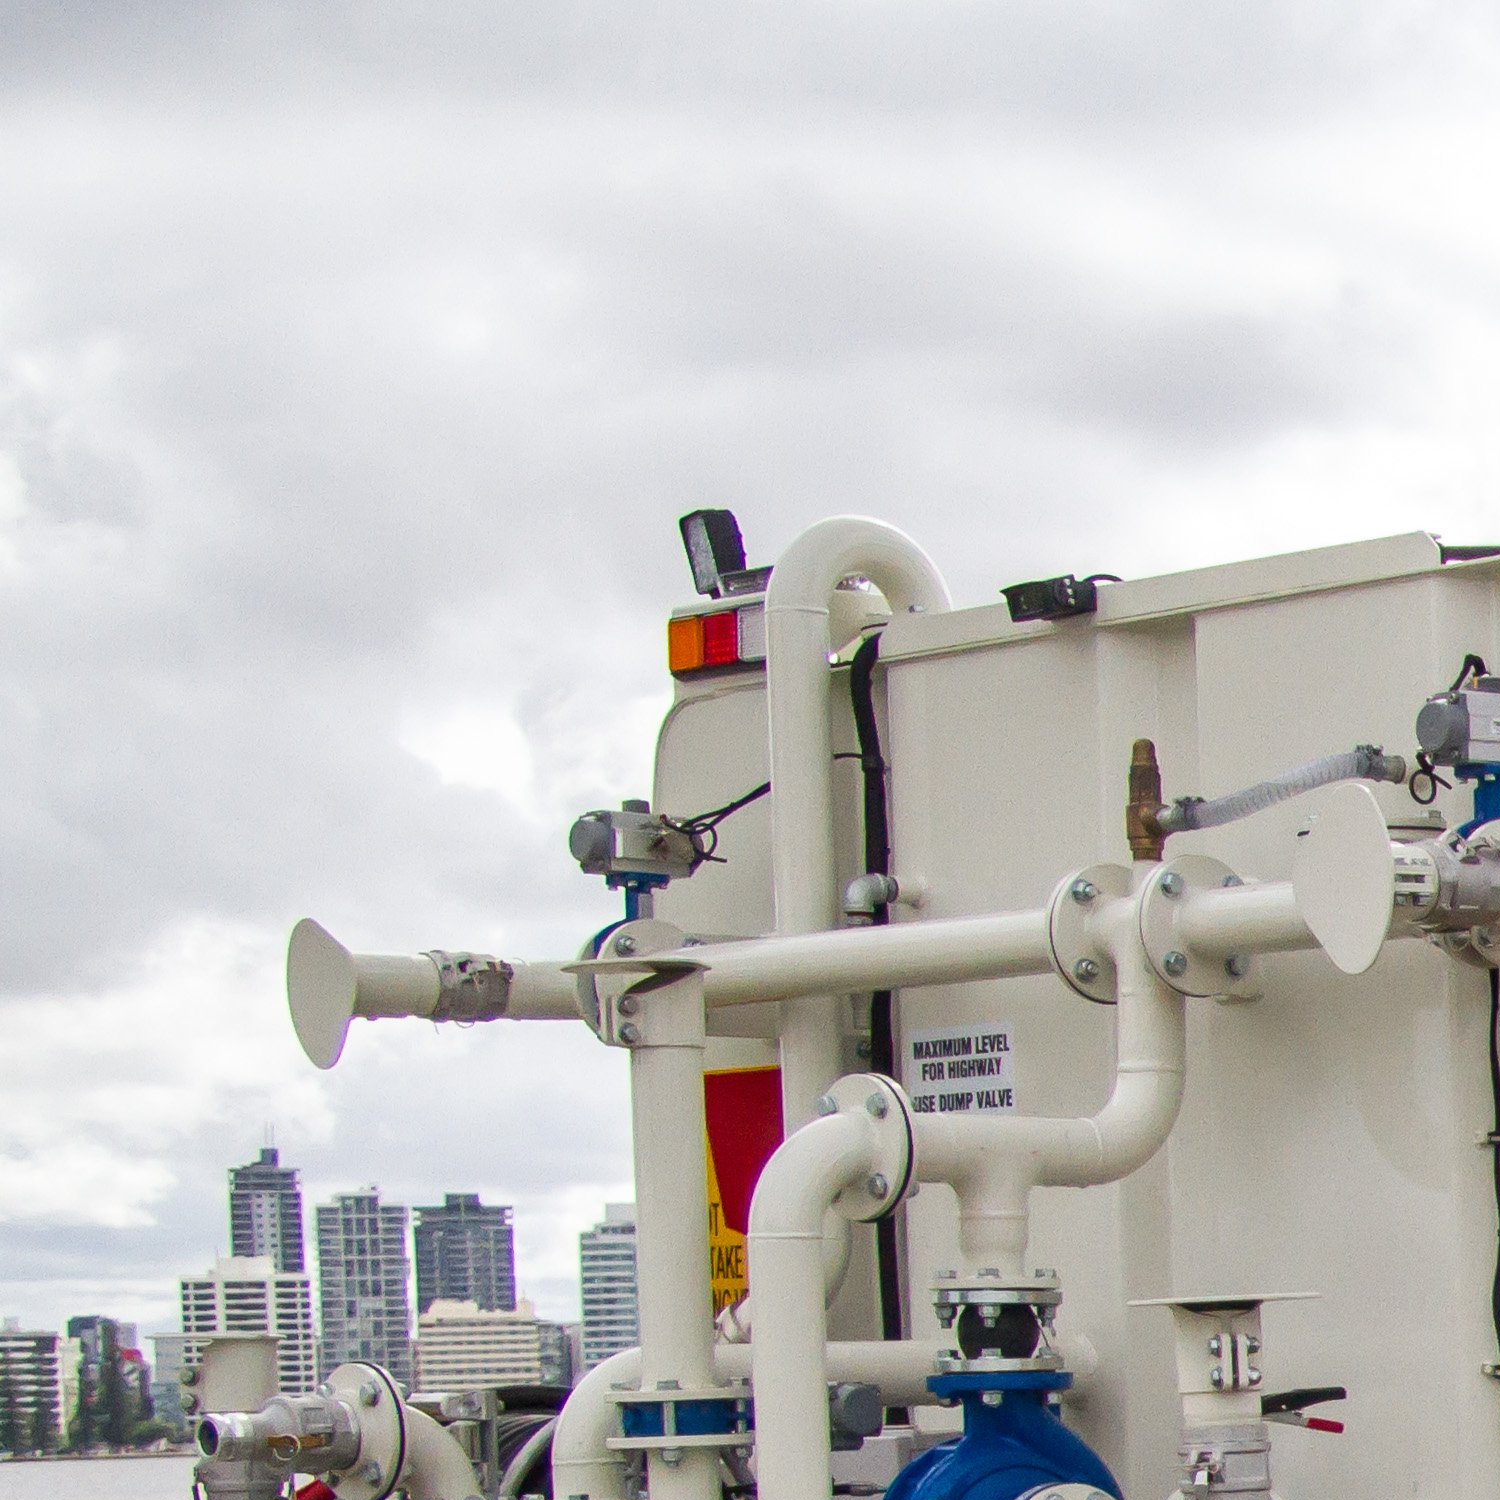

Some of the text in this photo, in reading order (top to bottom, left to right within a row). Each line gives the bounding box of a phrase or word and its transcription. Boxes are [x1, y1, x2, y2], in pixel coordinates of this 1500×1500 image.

[913, 1034, 1010, 1059] MAXIMUM LEVEL
[922, 1057, 1002, 1081] FOR HIGHWAY
[939, 1092, 973, 1112] DUMP
[977, 1088, 1013, 1109] VALVE
